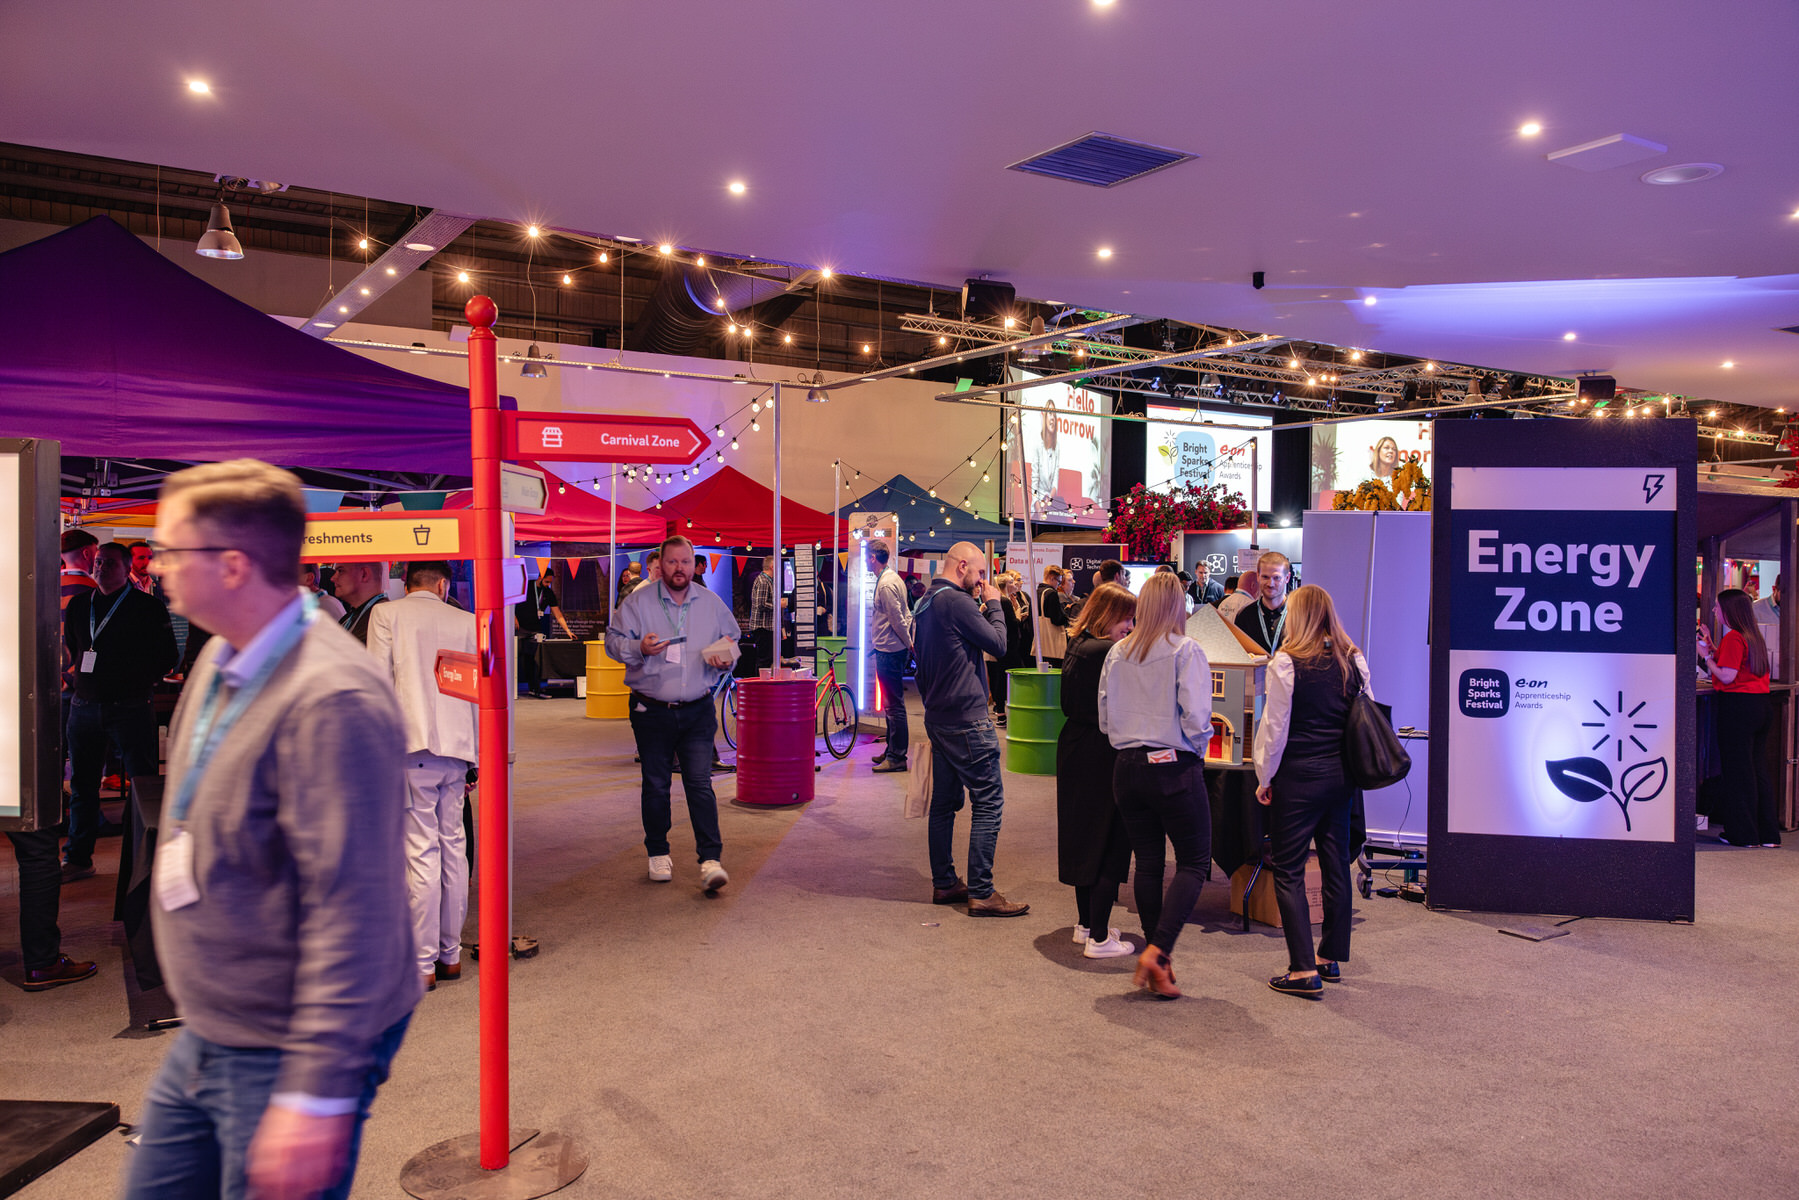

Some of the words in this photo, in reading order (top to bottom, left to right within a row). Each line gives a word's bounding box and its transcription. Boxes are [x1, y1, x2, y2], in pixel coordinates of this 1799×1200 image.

[1067, 386, 1095, 413] Hello
[600, 433, 649, 447] Carnival
[651, 435, 680, 448] Zone
[1183, 442, 1207, 455] Bright
[1181, 455, 1209, 467] Sparks
[1219, 460, 1263, 472] Appenticeip
[1179, 467, 1210, 479] Festival
[1219, 471, 1241, 480] Awards
[302, 532, 373, 545] reshments
[1468, 529, 1656, 588] Energy
[1494, 587, 1623, 632] Zone
[1469, 678, 1500, 689] Bright
[1467, 689, 1501, 699] Sparks
[1515, 691, 1571, 701] Apprenticeship
[1465, 699, 1503, 709] Festival
